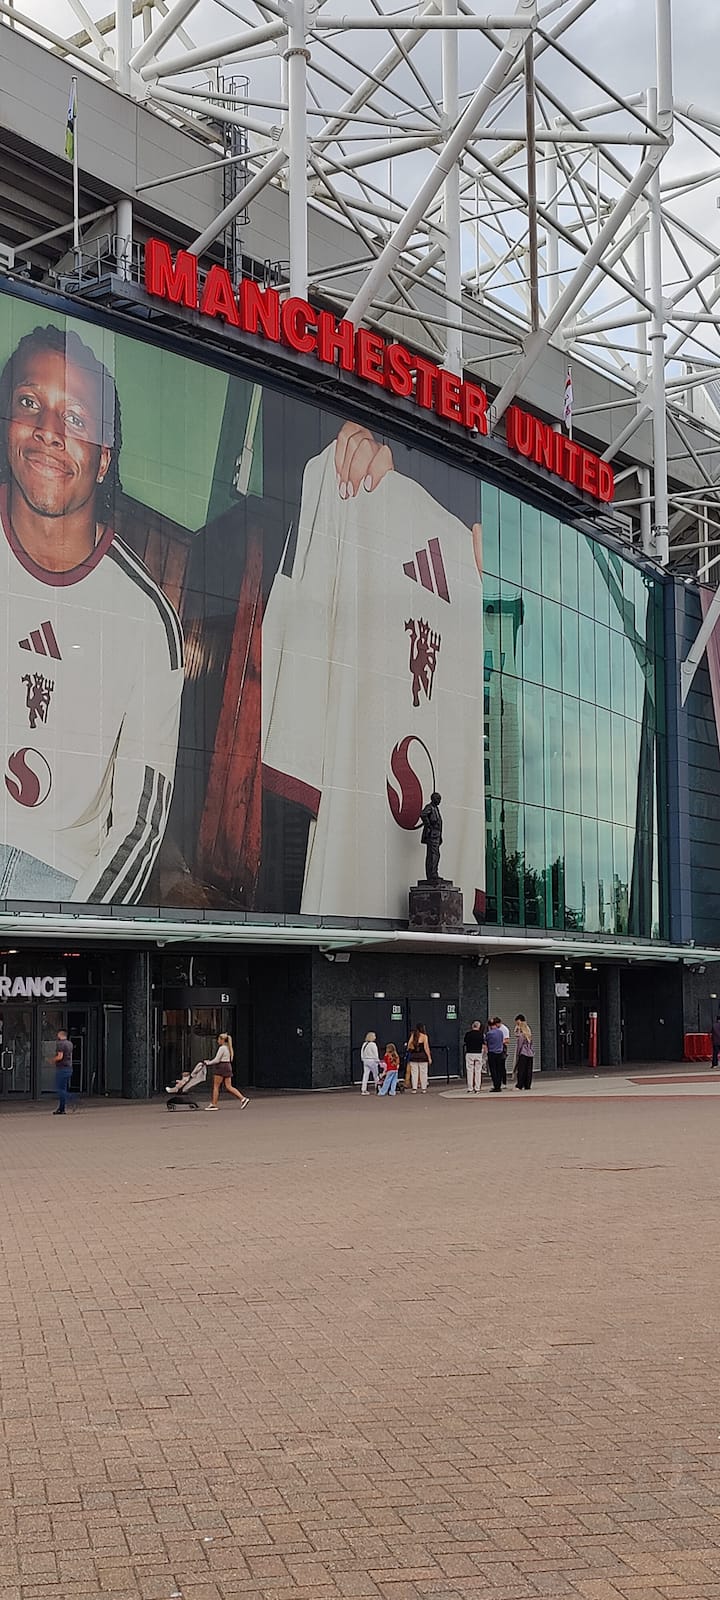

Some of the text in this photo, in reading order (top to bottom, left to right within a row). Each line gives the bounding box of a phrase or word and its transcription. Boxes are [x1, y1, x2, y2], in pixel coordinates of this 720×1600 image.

[145, 237, 615, 502] MANCHESTER UNITED
[0, 976, 67, 997] RANCE
